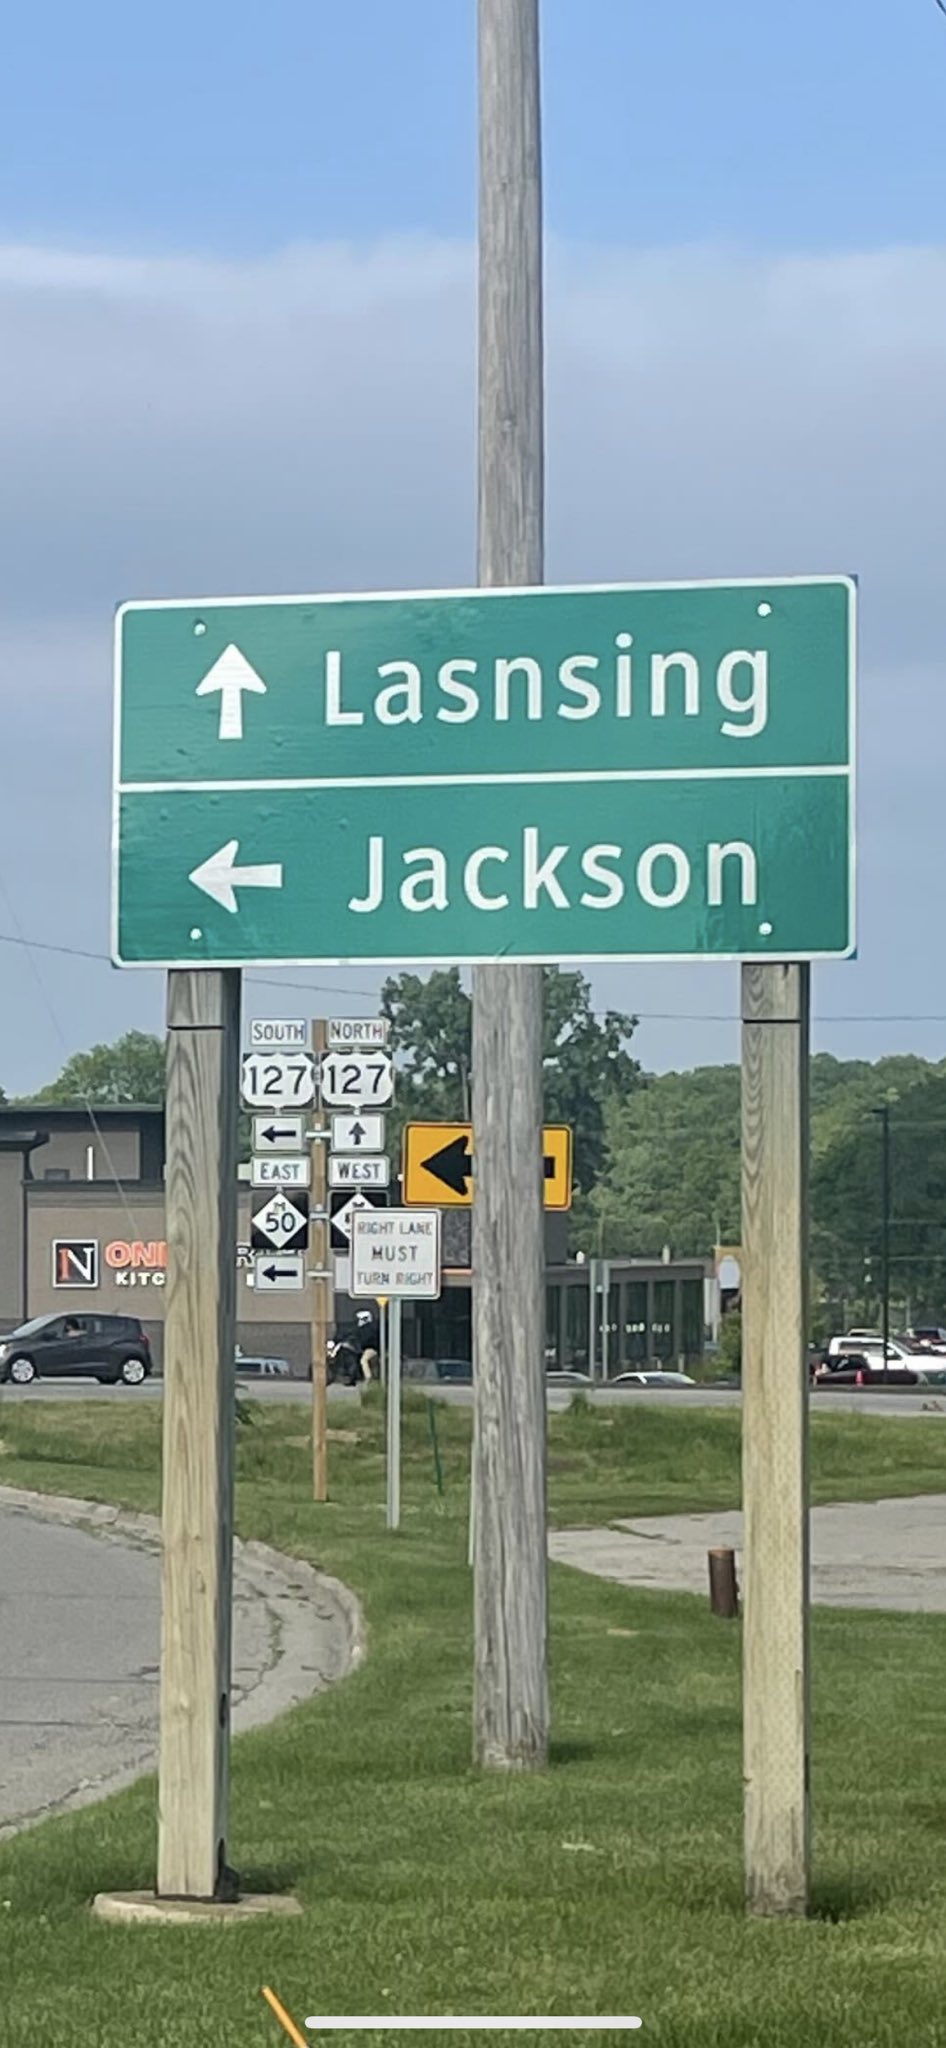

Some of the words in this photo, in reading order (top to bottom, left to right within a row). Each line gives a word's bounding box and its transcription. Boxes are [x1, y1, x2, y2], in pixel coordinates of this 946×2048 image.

[325, 632, 769, 738] Lasnsing
[348, 826, 758, 914] Jackson
[253, 1022, 305, 1041] SOUTH
[330, 1019, 384, 1039] NORTH
[249, 1065, 308, 1096] 127
[328, 1064, 386, 1095] 127
[259, 1162, 301, 1180] EAST
[337, 1161, 381, 1180] WEST
[265, 1212, 297, 1233] 50
[357, 1220, 395, 1235] RIGHT
[399, 1220, 433, 1236] LANE
[370, 1244, 418, 1262] MUST
[115, 1271, 166, 1287] KITC
[357, 1271, 390, 1286] TURN
[395, 1271, 434, 1286] RIGHT
